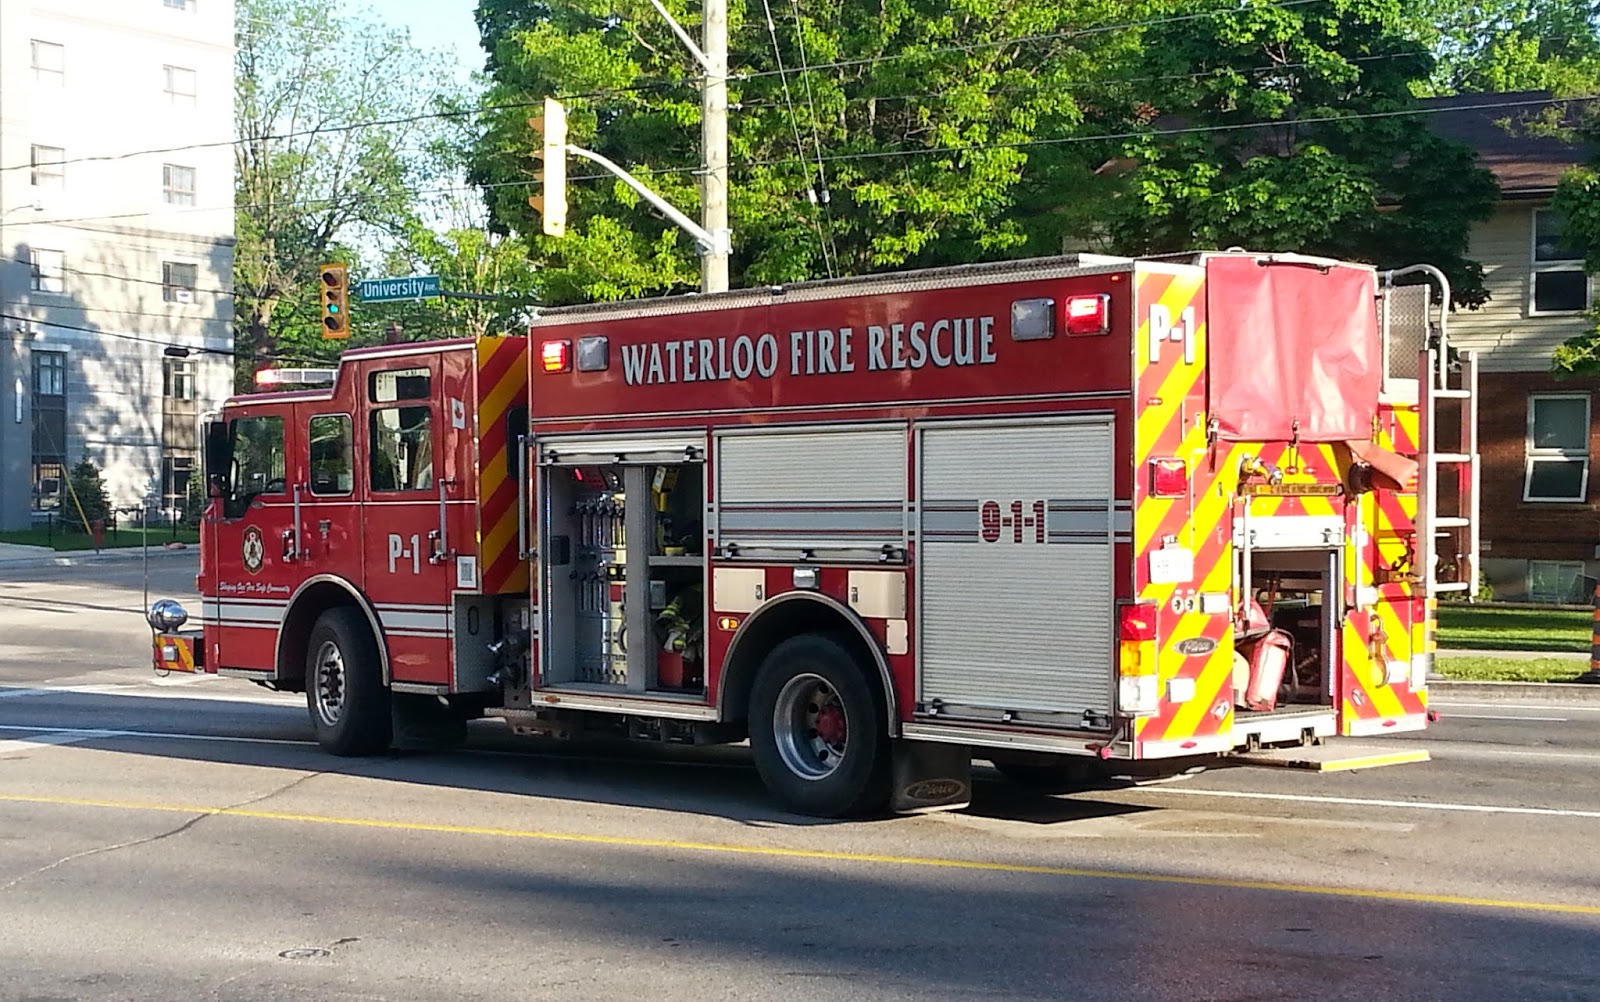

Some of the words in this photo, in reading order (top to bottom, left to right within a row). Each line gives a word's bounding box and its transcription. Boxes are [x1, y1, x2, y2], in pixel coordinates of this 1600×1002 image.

[363, 279, 425, 298] University
[621, 333, 779, 386] WATERLOO
[790, 327, 855, 376] FIRE
[867, 316, 997, 371] RESCUE
[1148, 303, 1196, 366] P-1
[981, 500, 1045, 543] 9-1-1
[388, 533, 420, 575] P-1
